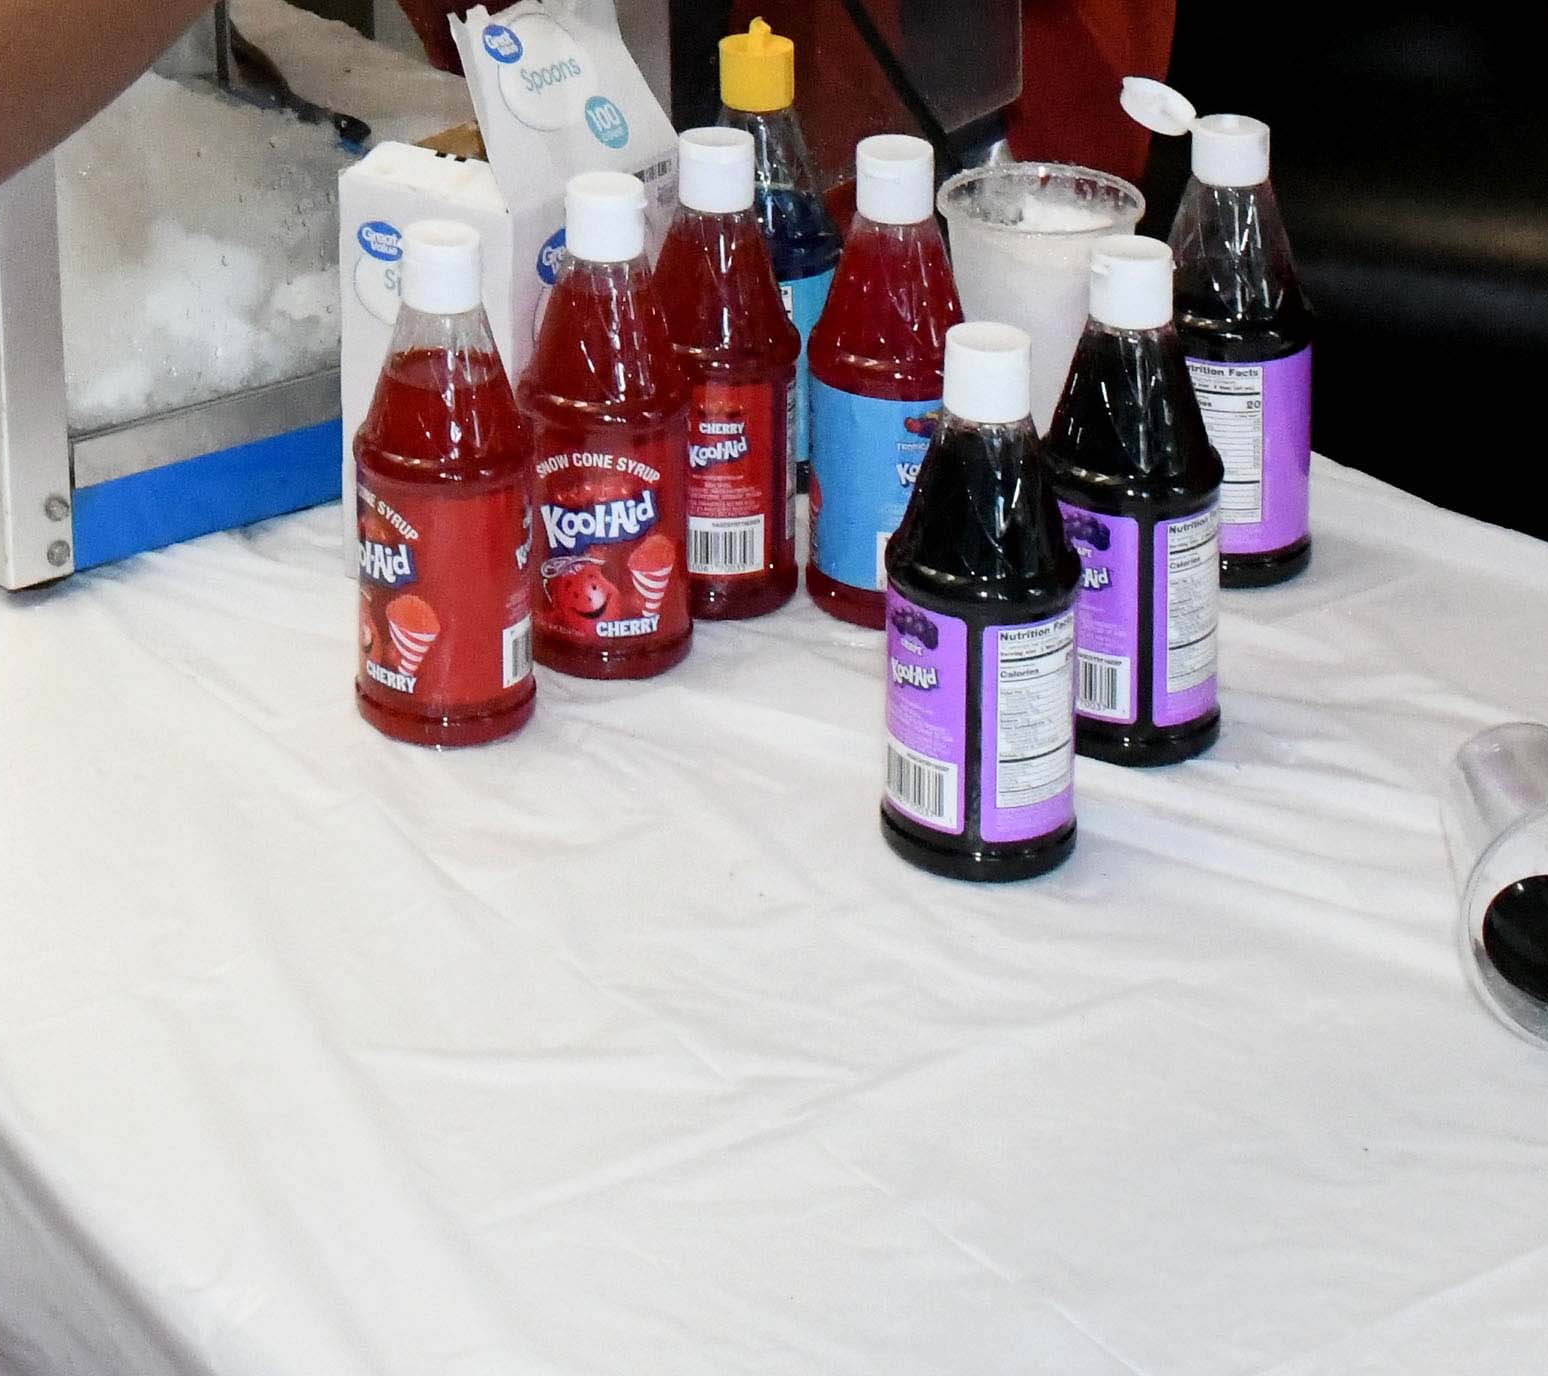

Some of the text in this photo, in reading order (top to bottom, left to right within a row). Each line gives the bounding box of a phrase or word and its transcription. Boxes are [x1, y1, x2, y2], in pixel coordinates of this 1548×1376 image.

[519, 57, 584, 96] Spoons
[588, 104, 621, 132] 100
[361, 227, 400, 247] Great
[1190, 365, 1259, 377] trition Facts
[698, 421, 746, 435] CHERRY
[687, 435, 748, 468] Kool-Aid
[536, 452, 661, 484] SNOW CONE SYRUP
[377, 501, 420, 541] SYRUP
[540, 489, 655, 549] Kool-Aid
[596, 614, 661, 638] CHERRY
[1000, 627, 1051, 642] Nutrition
[366, 660, 417, 694] CHERRY
[1000, 668, 1040, 679] Calories
